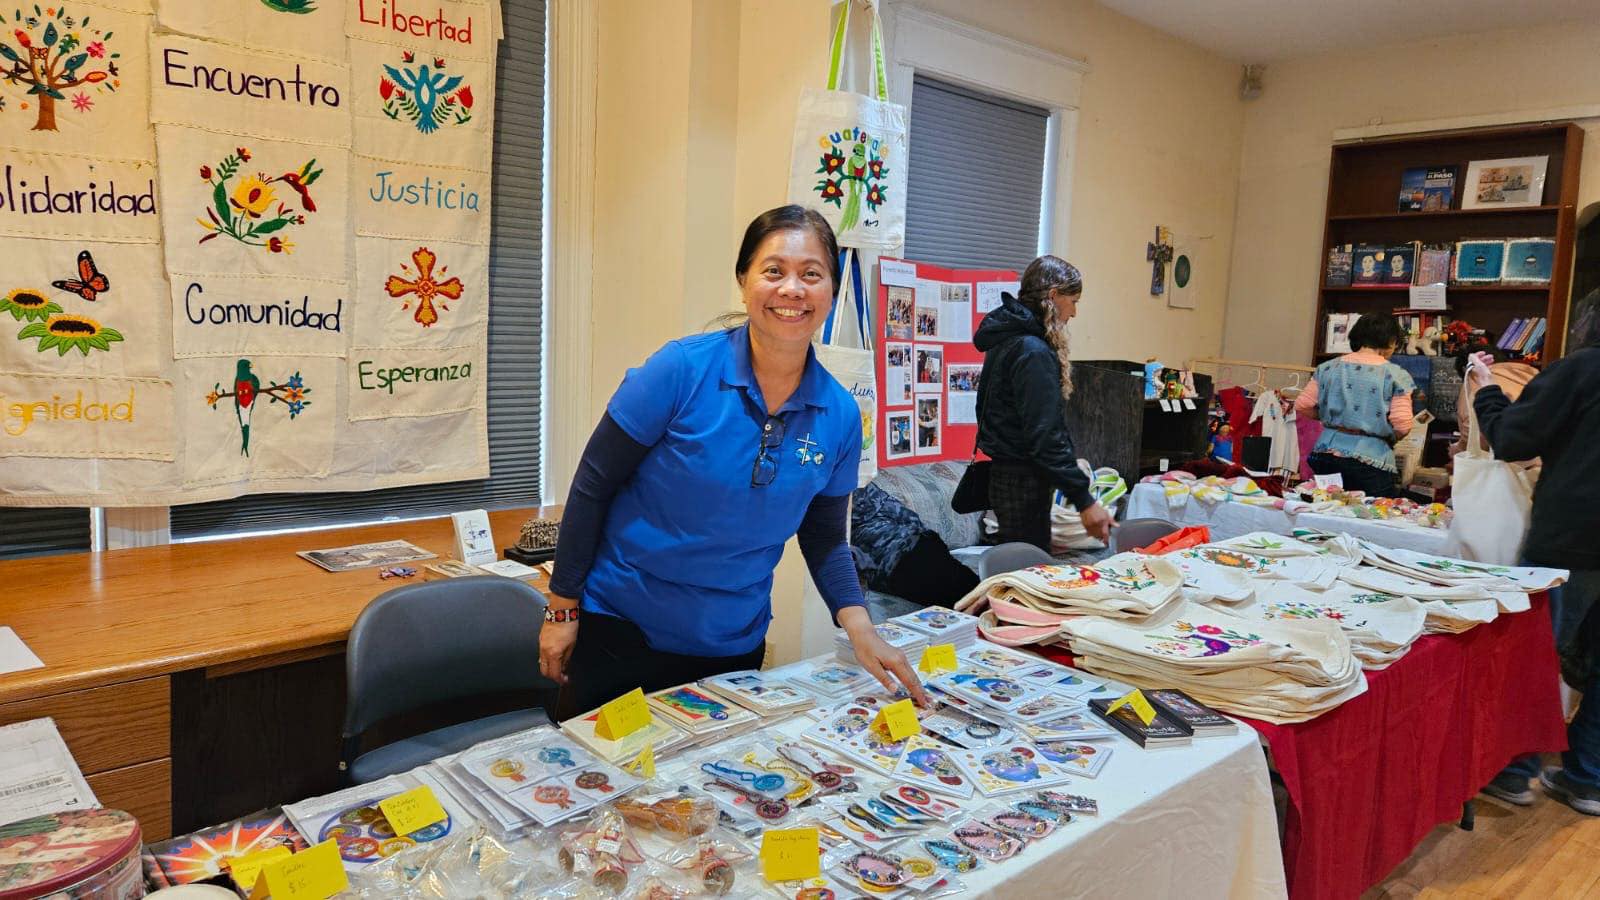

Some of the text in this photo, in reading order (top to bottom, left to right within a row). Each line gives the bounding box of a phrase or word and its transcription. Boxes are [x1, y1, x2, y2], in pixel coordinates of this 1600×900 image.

[359, 0, 472, 44] Libertad
[164, 48, 340, 107] Encuentro
[0, 165, 157, 216] lidaridad
[370, 171, 479, 212] Justicia
[186, 283, 342, 332] Comunidad
[358, 361, 472, 394] Esperanza
